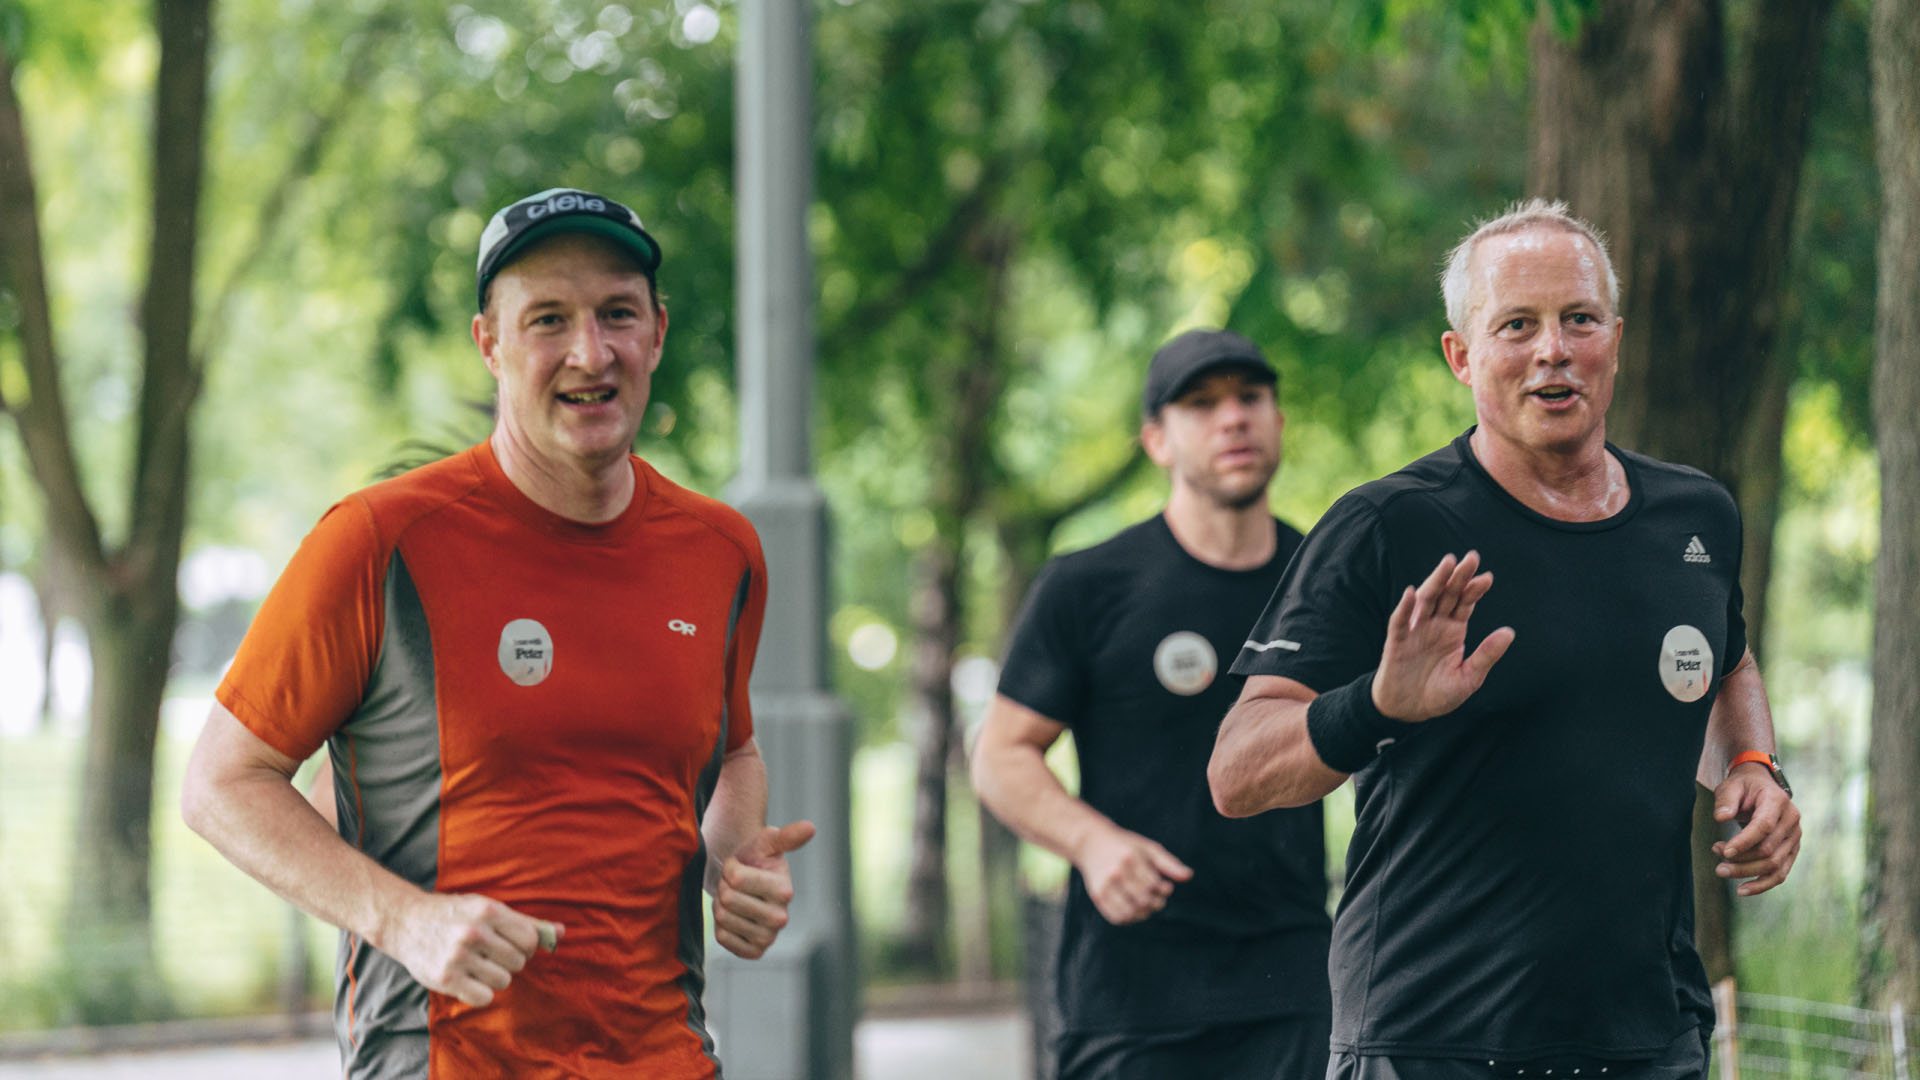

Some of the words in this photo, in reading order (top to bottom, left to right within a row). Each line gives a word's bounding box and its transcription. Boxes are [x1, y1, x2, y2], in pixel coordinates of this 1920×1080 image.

[1683, 553, 1711, 563] adidas
[668, 619, 697, 636] OR
[515, 648, 543, 660] Peter
[1676, 659, 1701, 672] Peter
